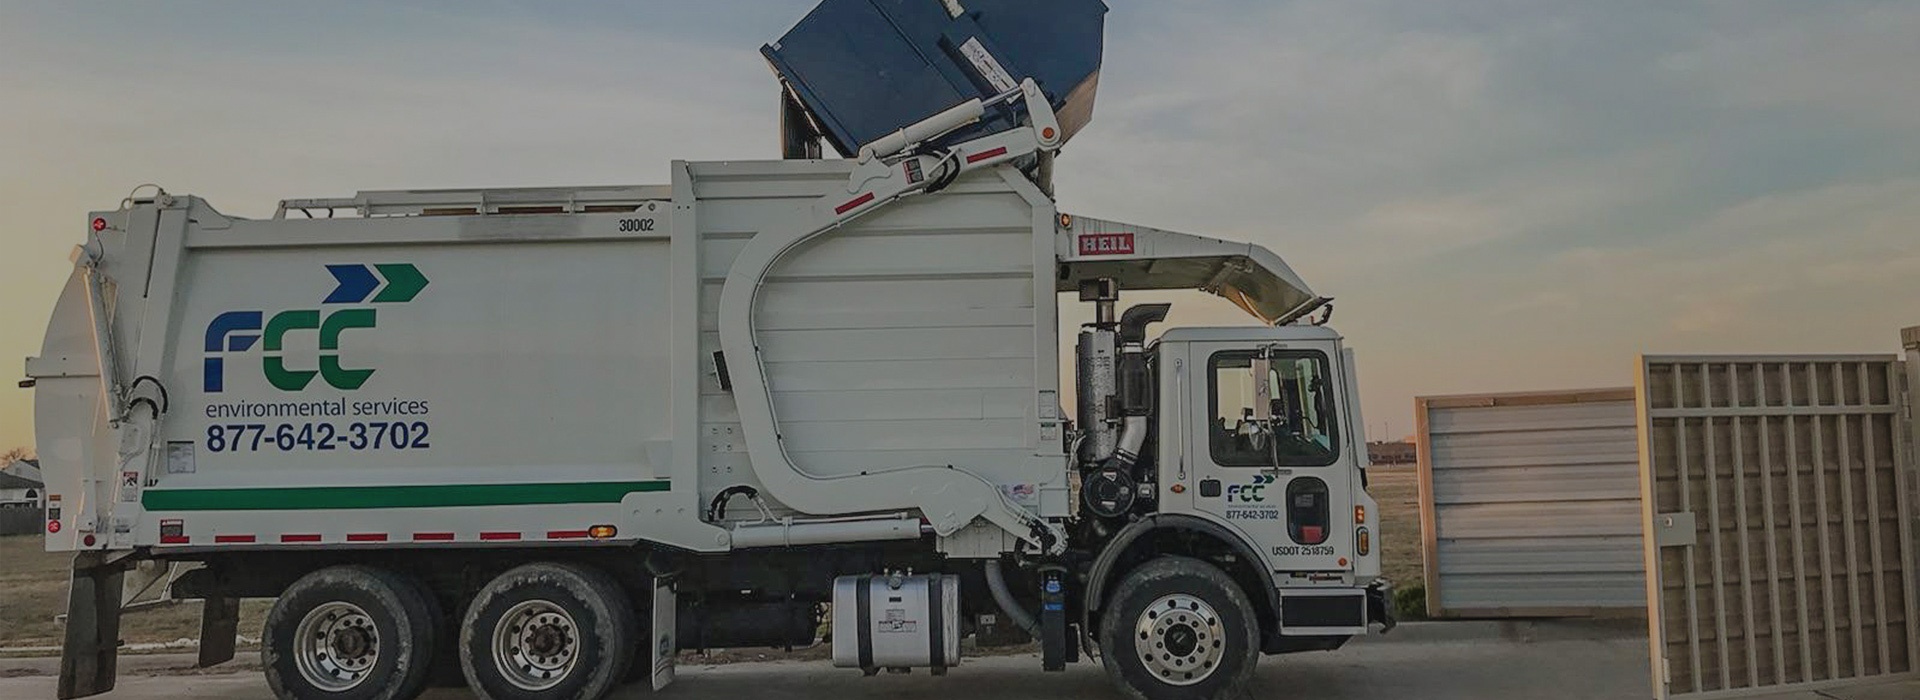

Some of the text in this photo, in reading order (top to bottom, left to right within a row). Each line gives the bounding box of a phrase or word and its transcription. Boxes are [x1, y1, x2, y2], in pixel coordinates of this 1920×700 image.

[619, 218, 654, 232] 30002
[1082, 236, 1131, 251] HEIL
[204, 308, 377, 393] FCC
[205, 397, 429, 418] environmental services
[206, 421, 430, 452] 877-642-3702
[1227, 485, 1265, 502] FCC
[1226, 510, 1279, 520] 877-642-3702
[1272, 546, 1335, 556] USDOT 2518759
